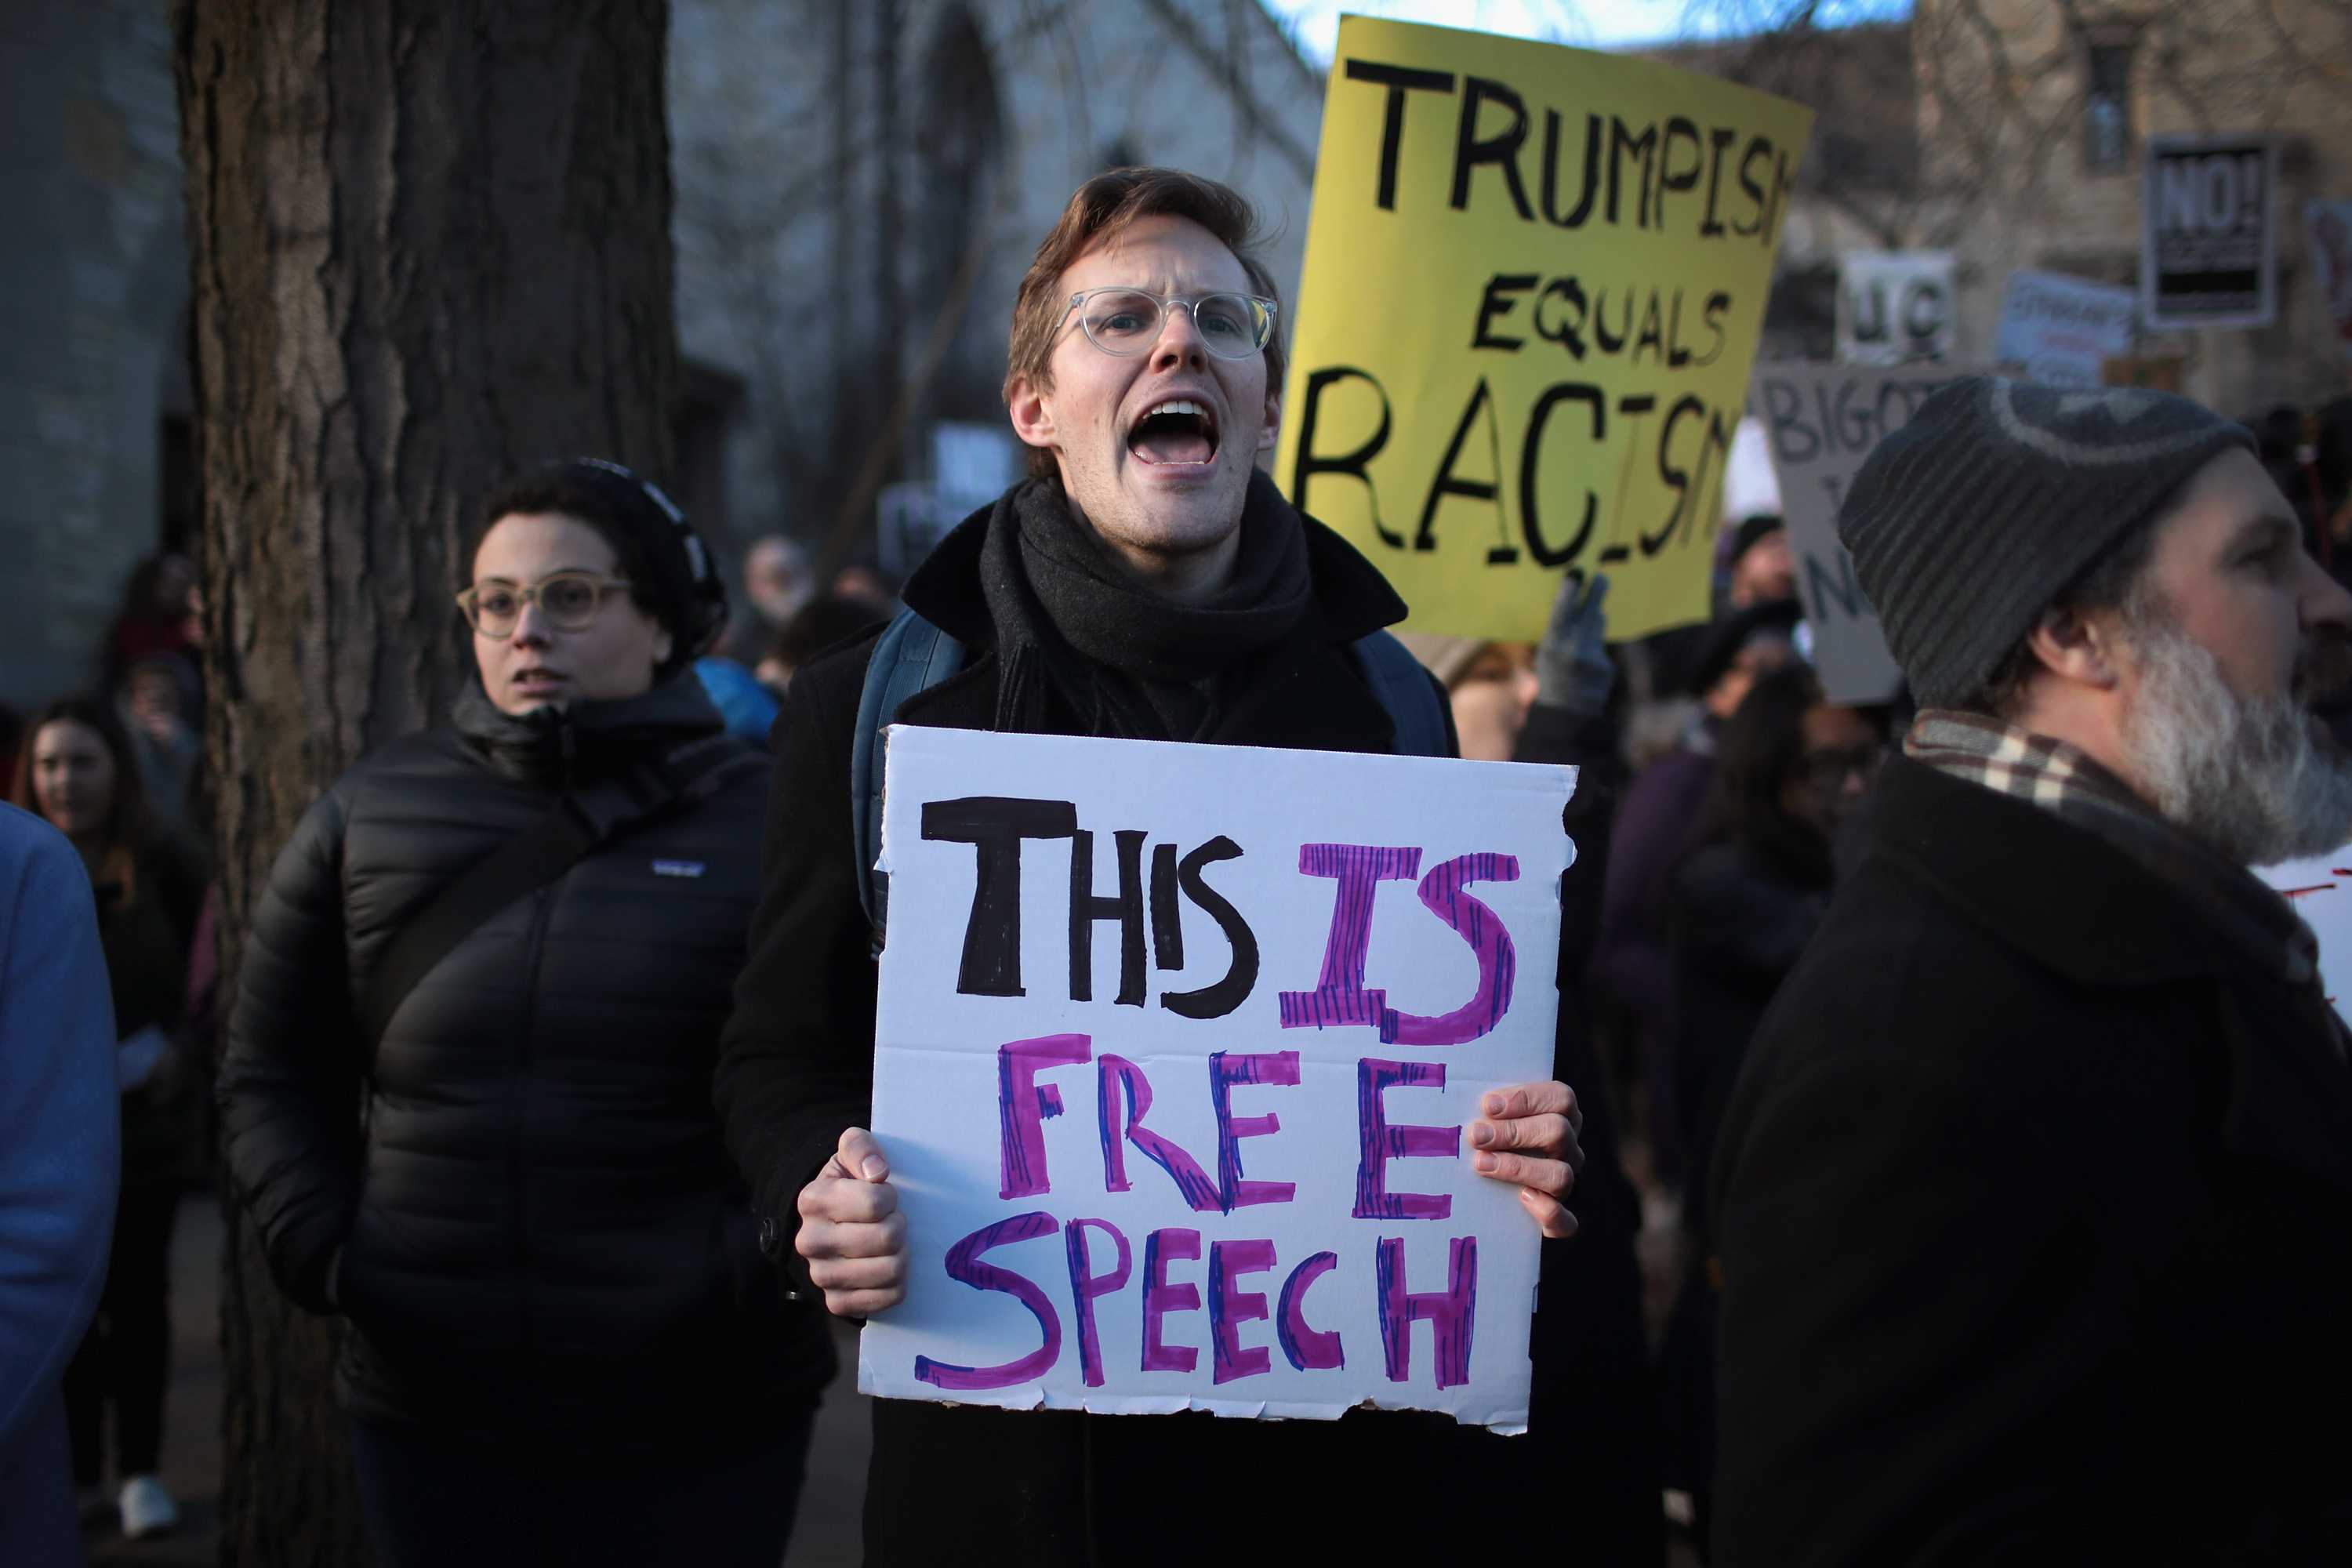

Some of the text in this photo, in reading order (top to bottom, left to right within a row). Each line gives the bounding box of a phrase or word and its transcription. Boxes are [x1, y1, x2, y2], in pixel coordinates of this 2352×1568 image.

[2158, 154, 2259, 230] NO!
[1471, 273, 1731, 368] EQUALS
[920, 796, 1520, 1047] THIS IS
[998, 1033, 1462, 1220] FREE
[914, 1210, 1477, 1391] SPEECH
